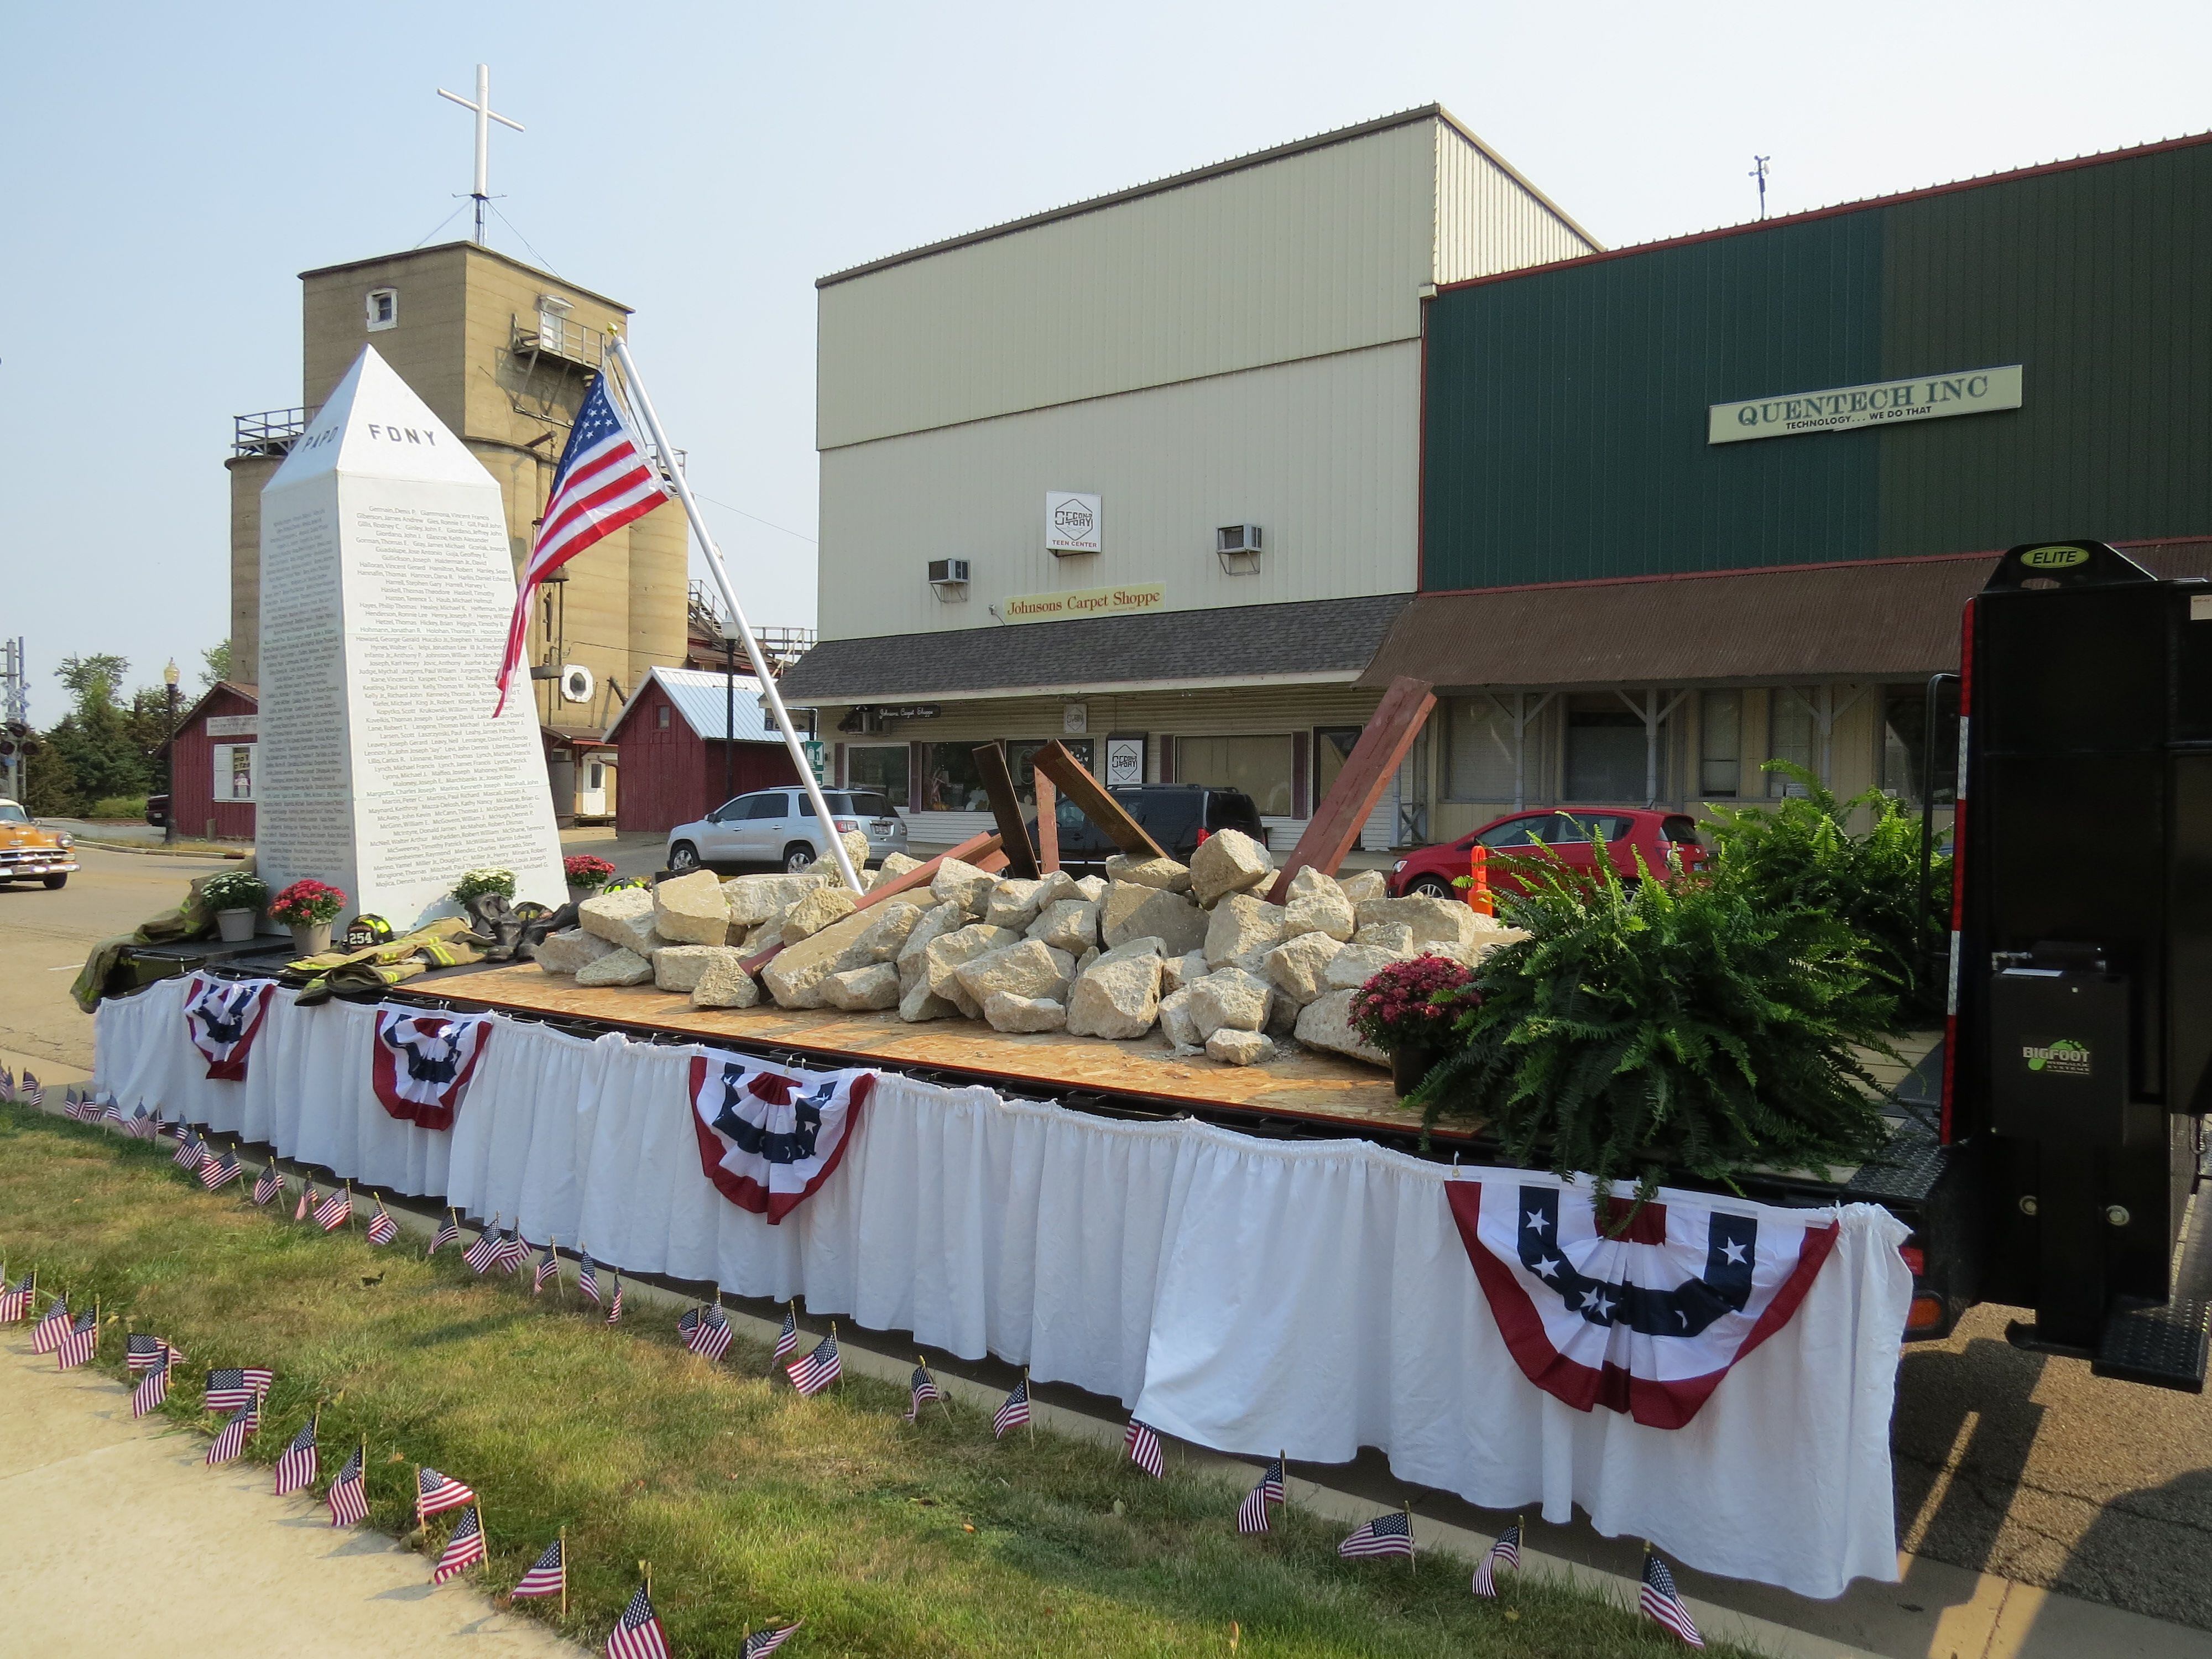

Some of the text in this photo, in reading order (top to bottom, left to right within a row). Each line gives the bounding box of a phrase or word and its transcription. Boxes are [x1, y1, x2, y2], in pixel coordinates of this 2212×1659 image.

[1737, 375, 1989, 426] QUENTECH INC
[1869, 410, 1884, 420] WE
[1887, 408, 1903, 418] DO
[1906, 405, 1932, 416] THAT
[301, 426, 339, 453] PAPD
[367, 424, 436, 446] FDNY
[2033, 551, 2078, 564] ELITE
[1007, 591, 1160, 615] Johnsons Carpet Shoppe
[349, 932, 373, 944] 254
[2023, 1047, 2090, 1062] BIGFOOT
